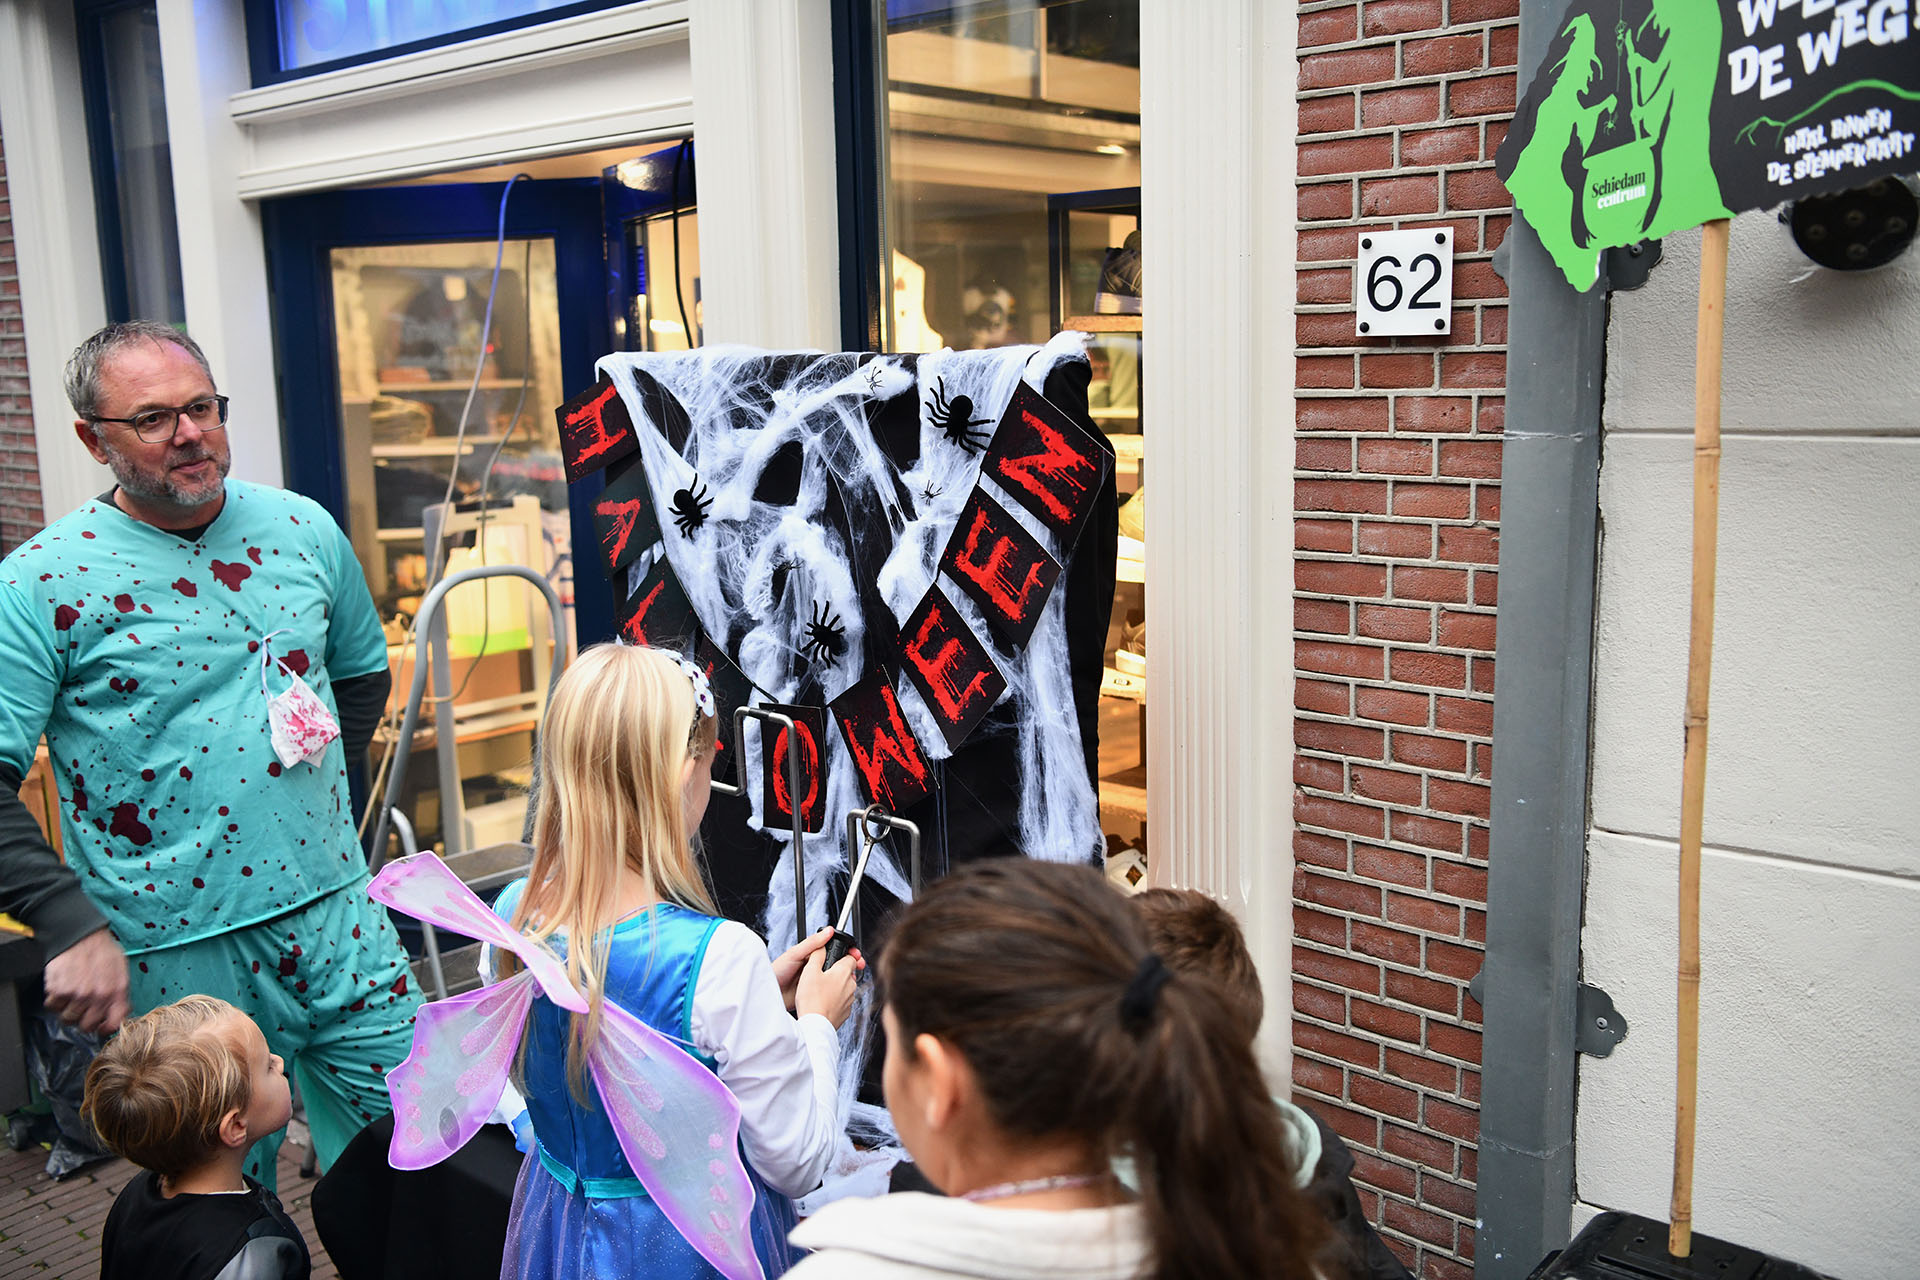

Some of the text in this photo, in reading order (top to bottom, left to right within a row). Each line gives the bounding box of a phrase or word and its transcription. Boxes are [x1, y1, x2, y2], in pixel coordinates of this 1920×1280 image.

[1728, 44, 1792, 99] DE
[1784, 124, 1828, 154] HAAL
[1592, 171, 1646, 198] Schiedam
[1767, 161, 1793, 186] DE
[1597, 184, 1646, 209] centrum
[1367, 253, 1442, 312] 62
[563, 384, 1097, 818] HALOWEEN
